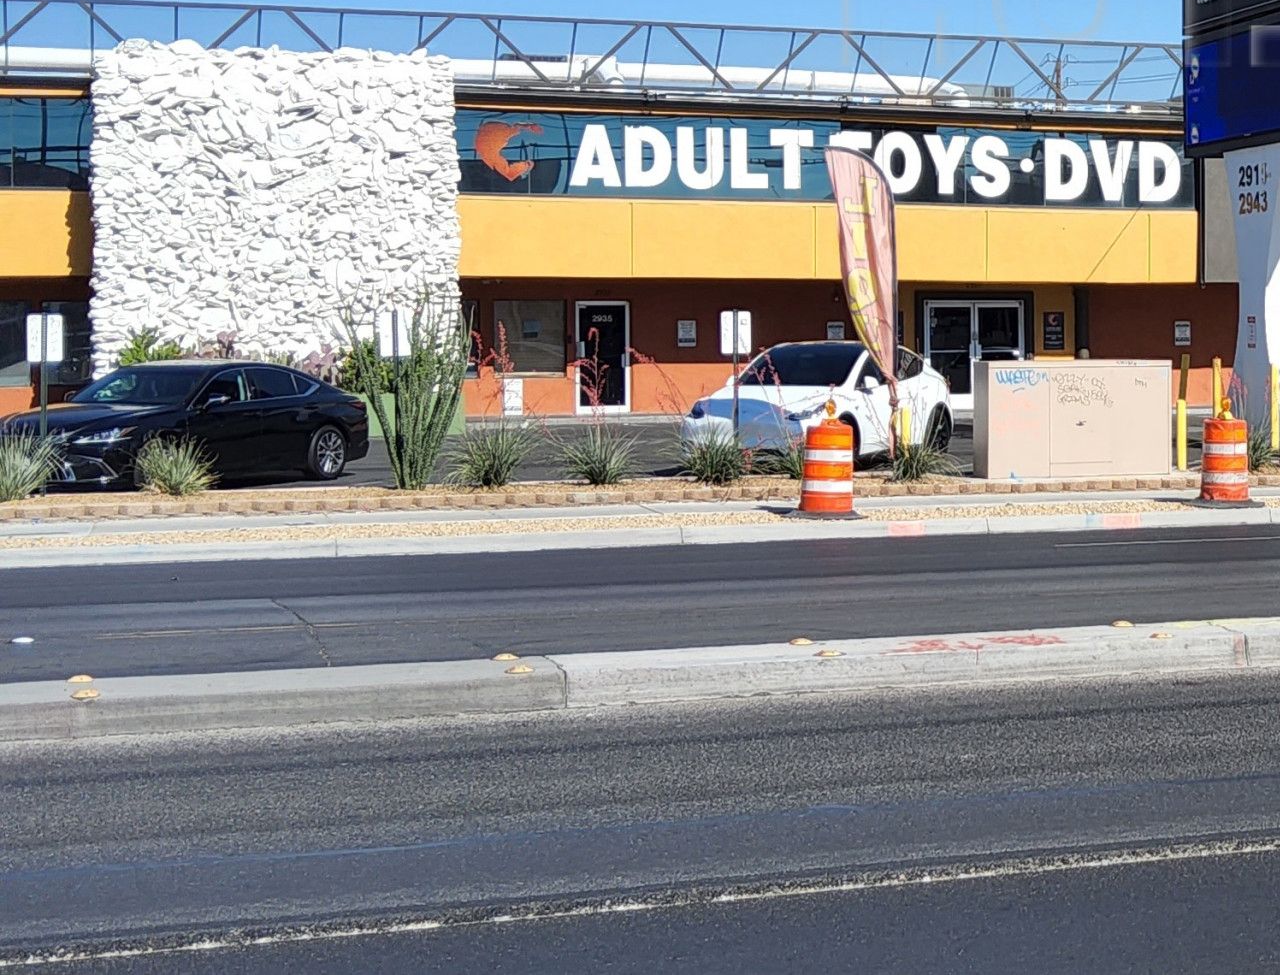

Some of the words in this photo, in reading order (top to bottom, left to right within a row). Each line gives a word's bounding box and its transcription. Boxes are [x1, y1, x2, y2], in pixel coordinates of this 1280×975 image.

[570, 124, 814, 190] ADULT
[1238, 190, 1269, 215] 2943
[591, 314, 613, 323] 2935
